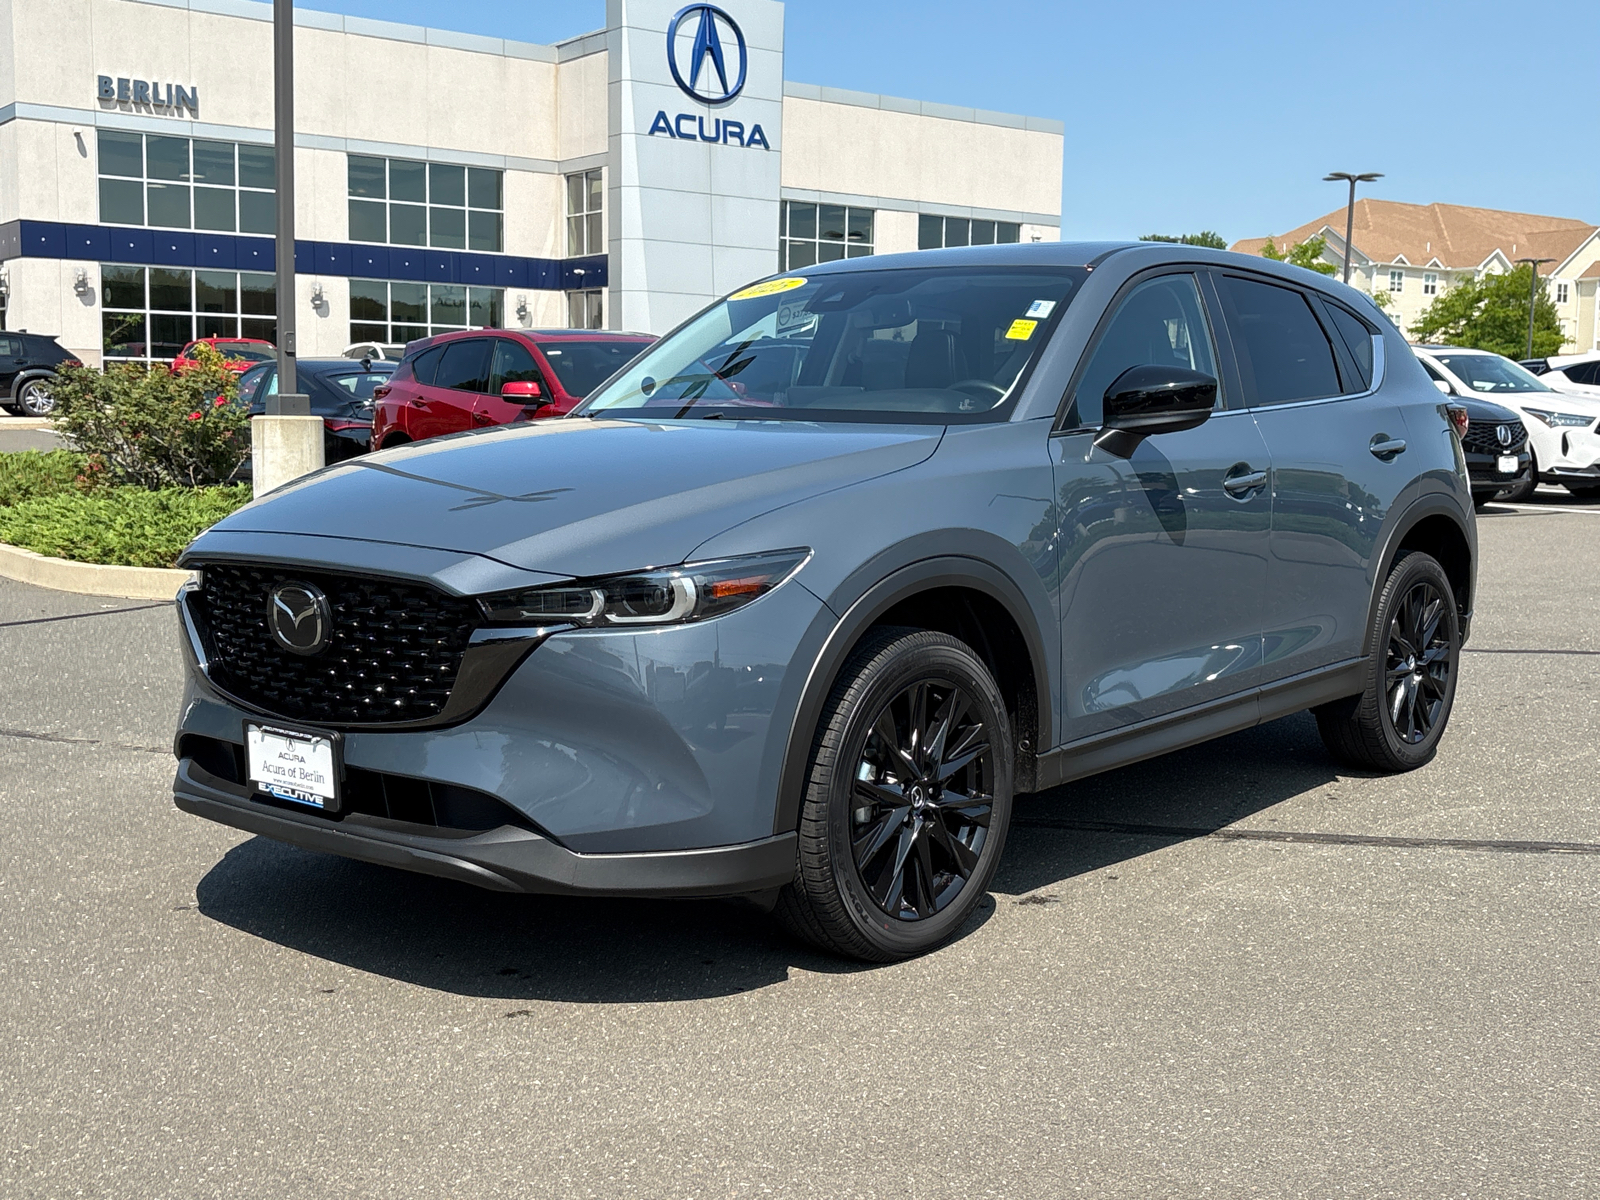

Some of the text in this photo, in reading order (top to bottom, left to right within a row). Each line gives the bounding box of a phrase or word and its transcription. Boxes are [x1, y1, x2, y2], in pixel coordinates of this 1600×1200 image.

[97, 75, 198, 111] BERLIN
[648, 110, 770, 151] ACURA
[435, 297, 482, 309] ACUA
[278, 751, 306, 764] ACURA
[262, 760, 325, 784] Acura of Berlin
[258, 781, 324, 805] EXECUTIVE
